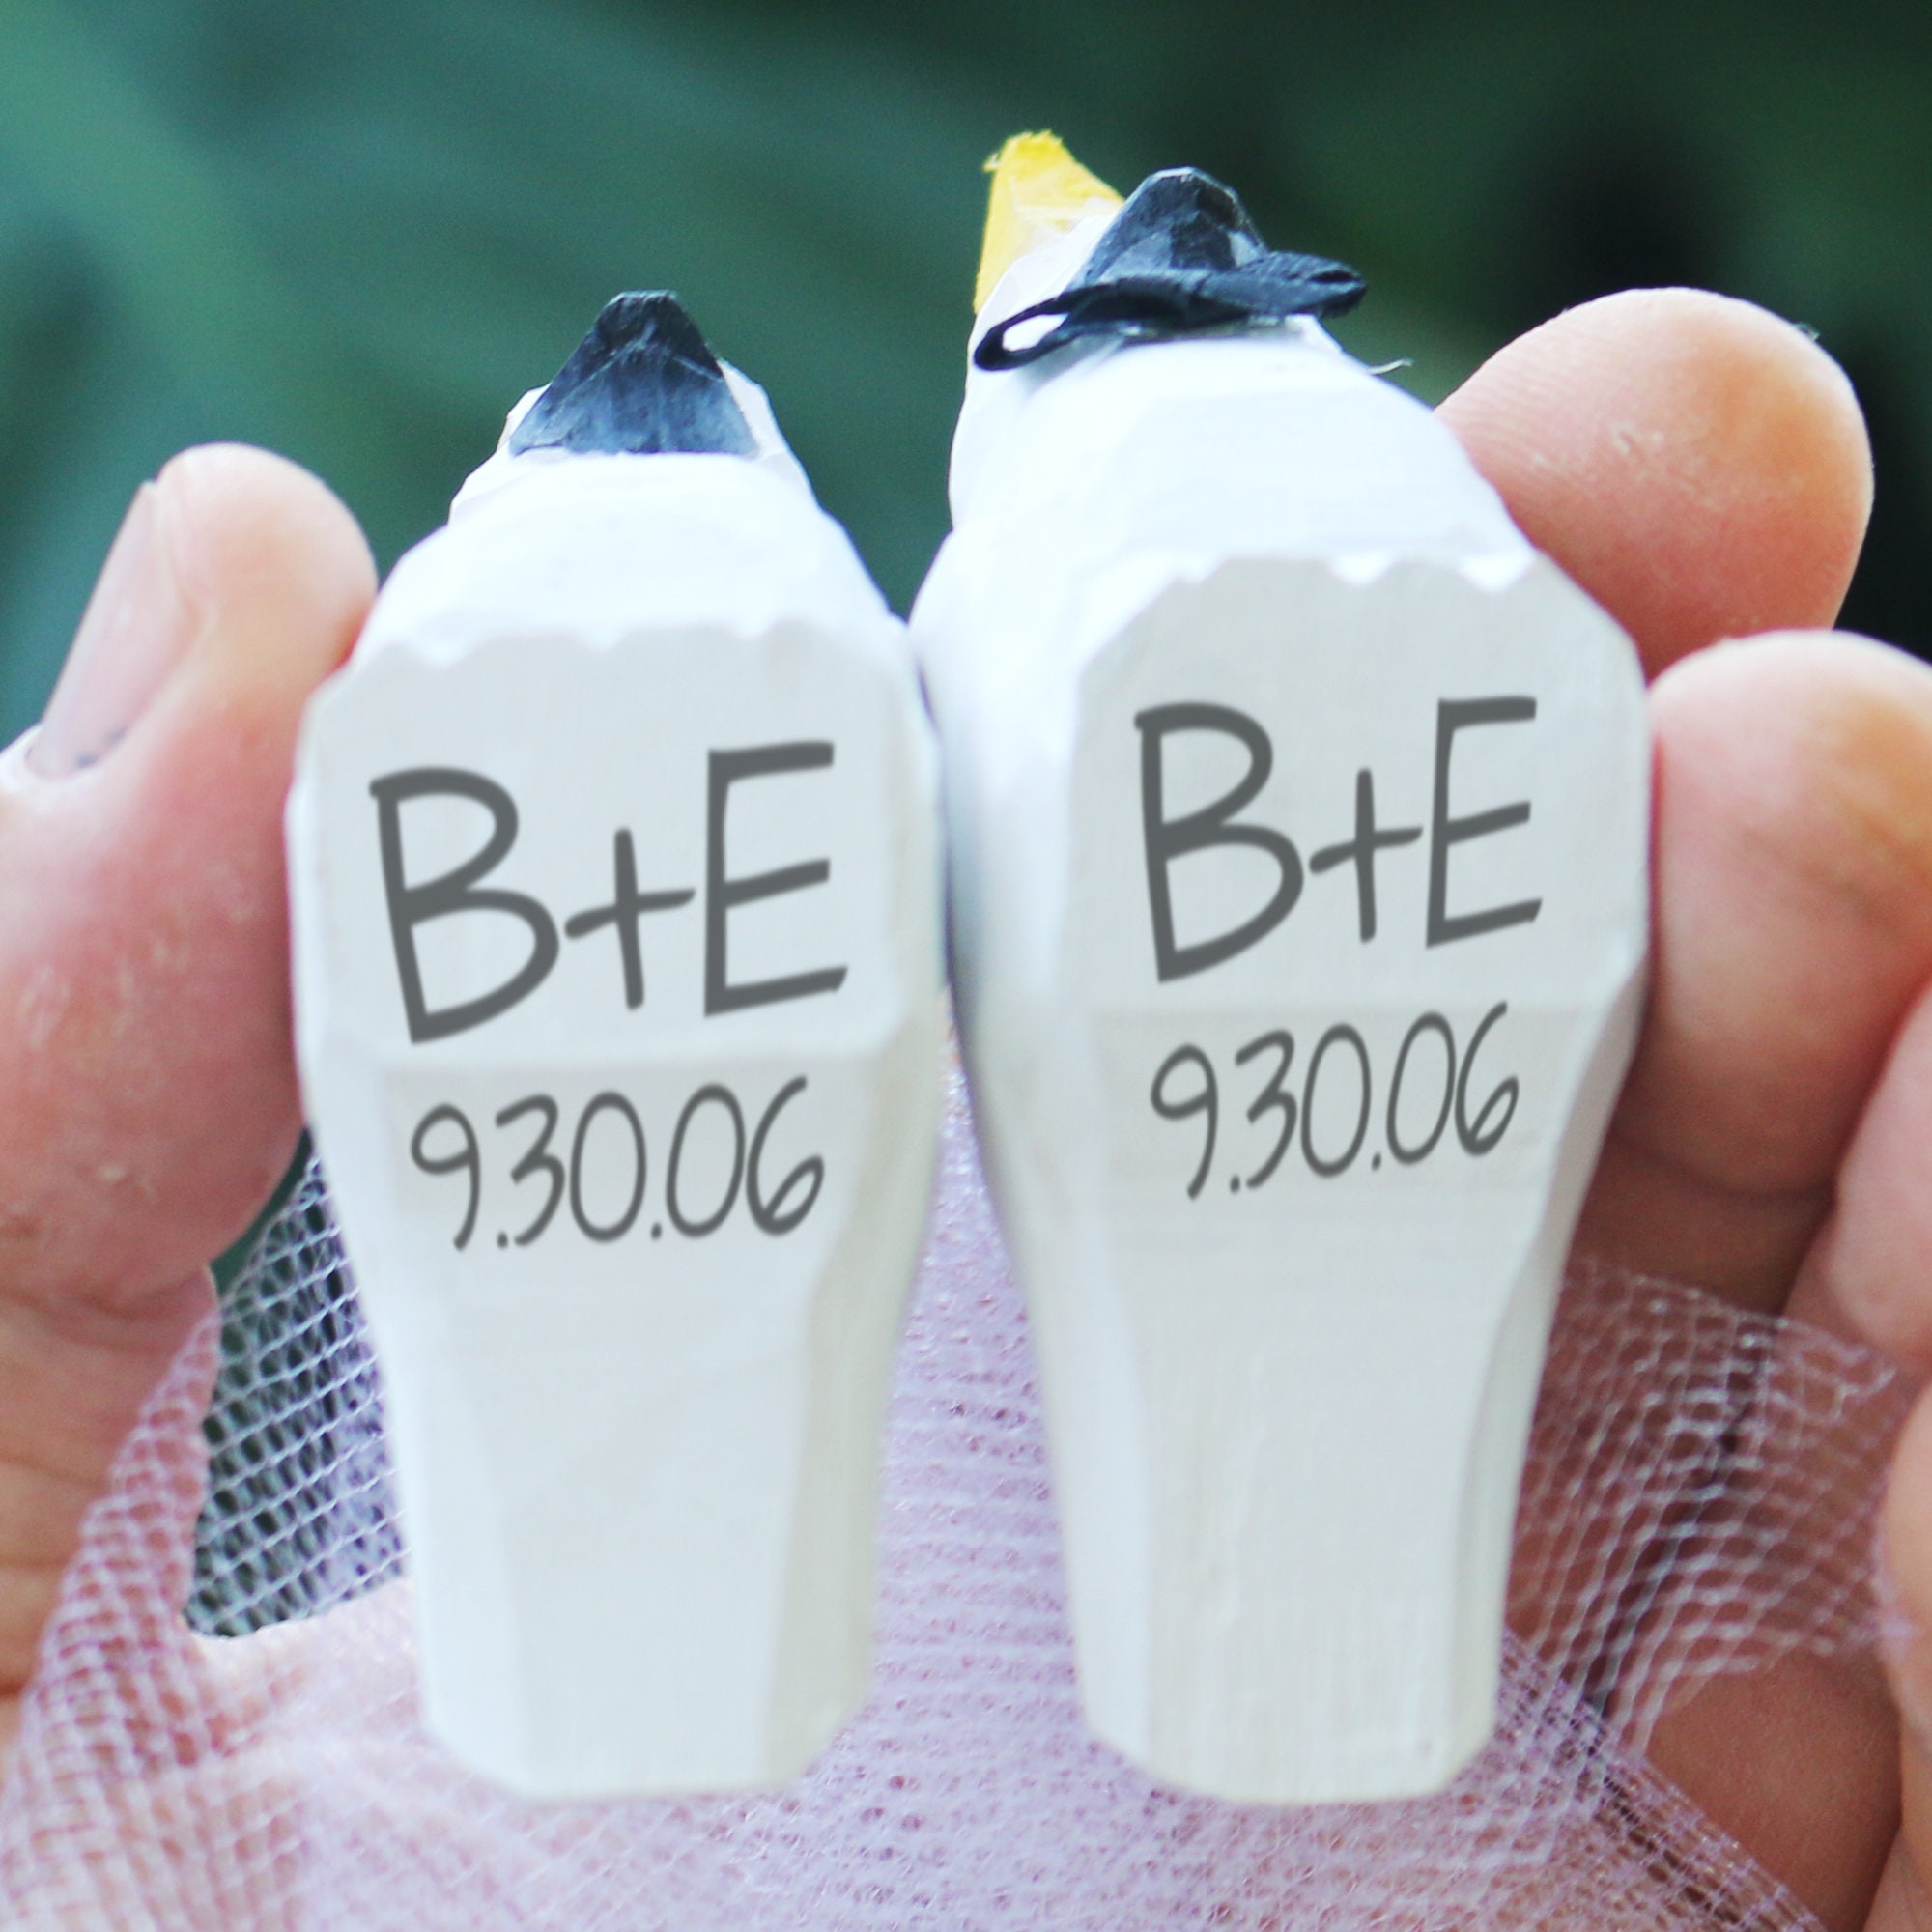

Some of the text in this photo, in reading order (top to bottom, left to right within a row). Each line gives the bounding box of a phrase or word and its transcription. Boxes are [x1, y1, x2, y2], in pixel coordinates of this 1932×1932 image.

[368, 740, 848, 1045] B+E
[1132, 695, 1543, 984] B+E
[410, 1075, 826, 1251] 9.30.06
[1149, 1001, 1520, 1201] 9.30.06
